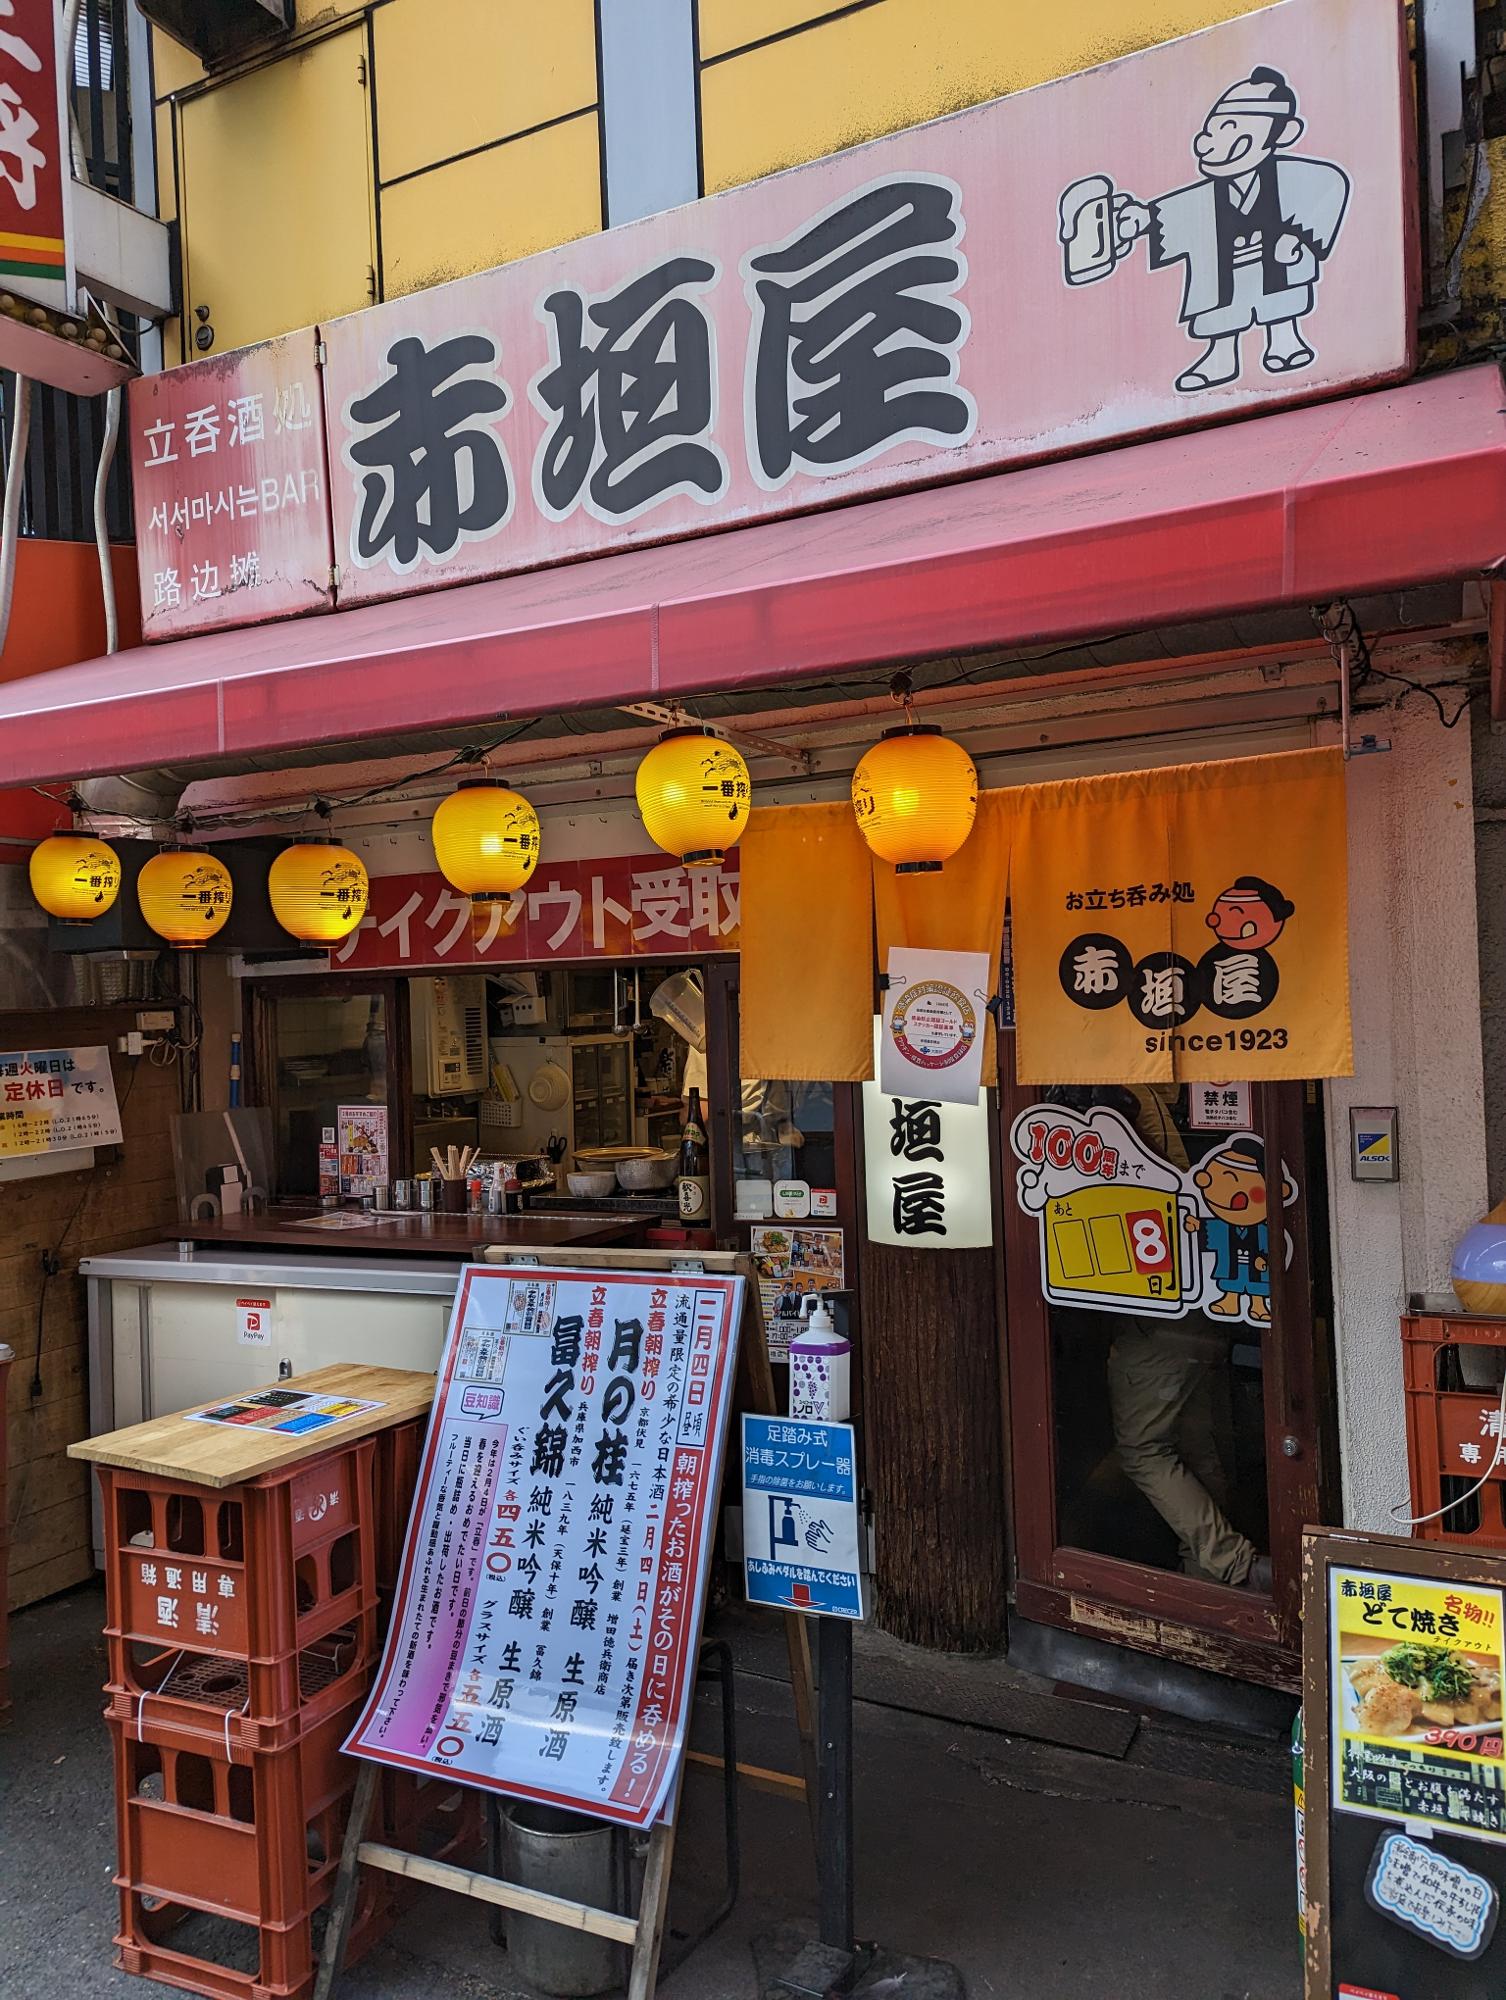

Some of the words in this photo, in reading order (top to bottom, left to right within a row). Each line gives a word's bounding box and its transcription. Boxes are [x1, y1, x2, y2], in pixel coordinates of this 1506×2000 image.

[349, 181, 969, 564] 赤垣屋
[143, 381, 312, 468] 立呑酒処
[148, 467, 320, 535] 서서마시는BAR
[153, 551, 261, 607] 路边摊
[1065, 881, 1195, 911] お立ち呑み処
[1073, 946, 1262, 1017] 赤垣屋
[1145, 1028, 1289, 1054] since1923
[0, 1059, 76, 1078] 週火曜日は
[1204, 1090, 1238, 1107] 禁煙
[1053, 1202, 1074, 1217] あと
[1132, 1218, 1167, 1265] 8
[1147, 1276, 1163, 1295] 日
[243, 1331, 265, 1341] PayPay
[580, 1285, 608, 1396] 立春朝搾り
[640, 1288, 668, 1401] 立春朝搾り
[687, 1299, 717, 1406] 二月四日
[464, 1391, 501, 1411] 豆知識
[648, 1295, 691, 1501] 流通量限定の希少な日本酒
[569, 1402, 589, 1467] 兵庫県加西市
[634, 1407, 650, 1449] 京都伏見
[767, 1424, 829, 1448] 足踏み式
[745, 1446, 851, 1476] 消毒スプレー器
[508, 1485, 553, 1620] 純米吟醸
[570, 1493, 615, 1631] 純米吟醸
[1341, 1579, 1393, 1602] 赤垣屋
[1444, 1594, 1495, 1629] 名物!!
[470, 1600, 499, 1665] グラスサイズ
[1362, 1601, 1460, 1637] どて焼き
[1433, 1636, 1492, 1651] テイクアウト
[474, 1640, 522, 1747] 生原酒
[538, 1652, 585, 1762] 生原酒
